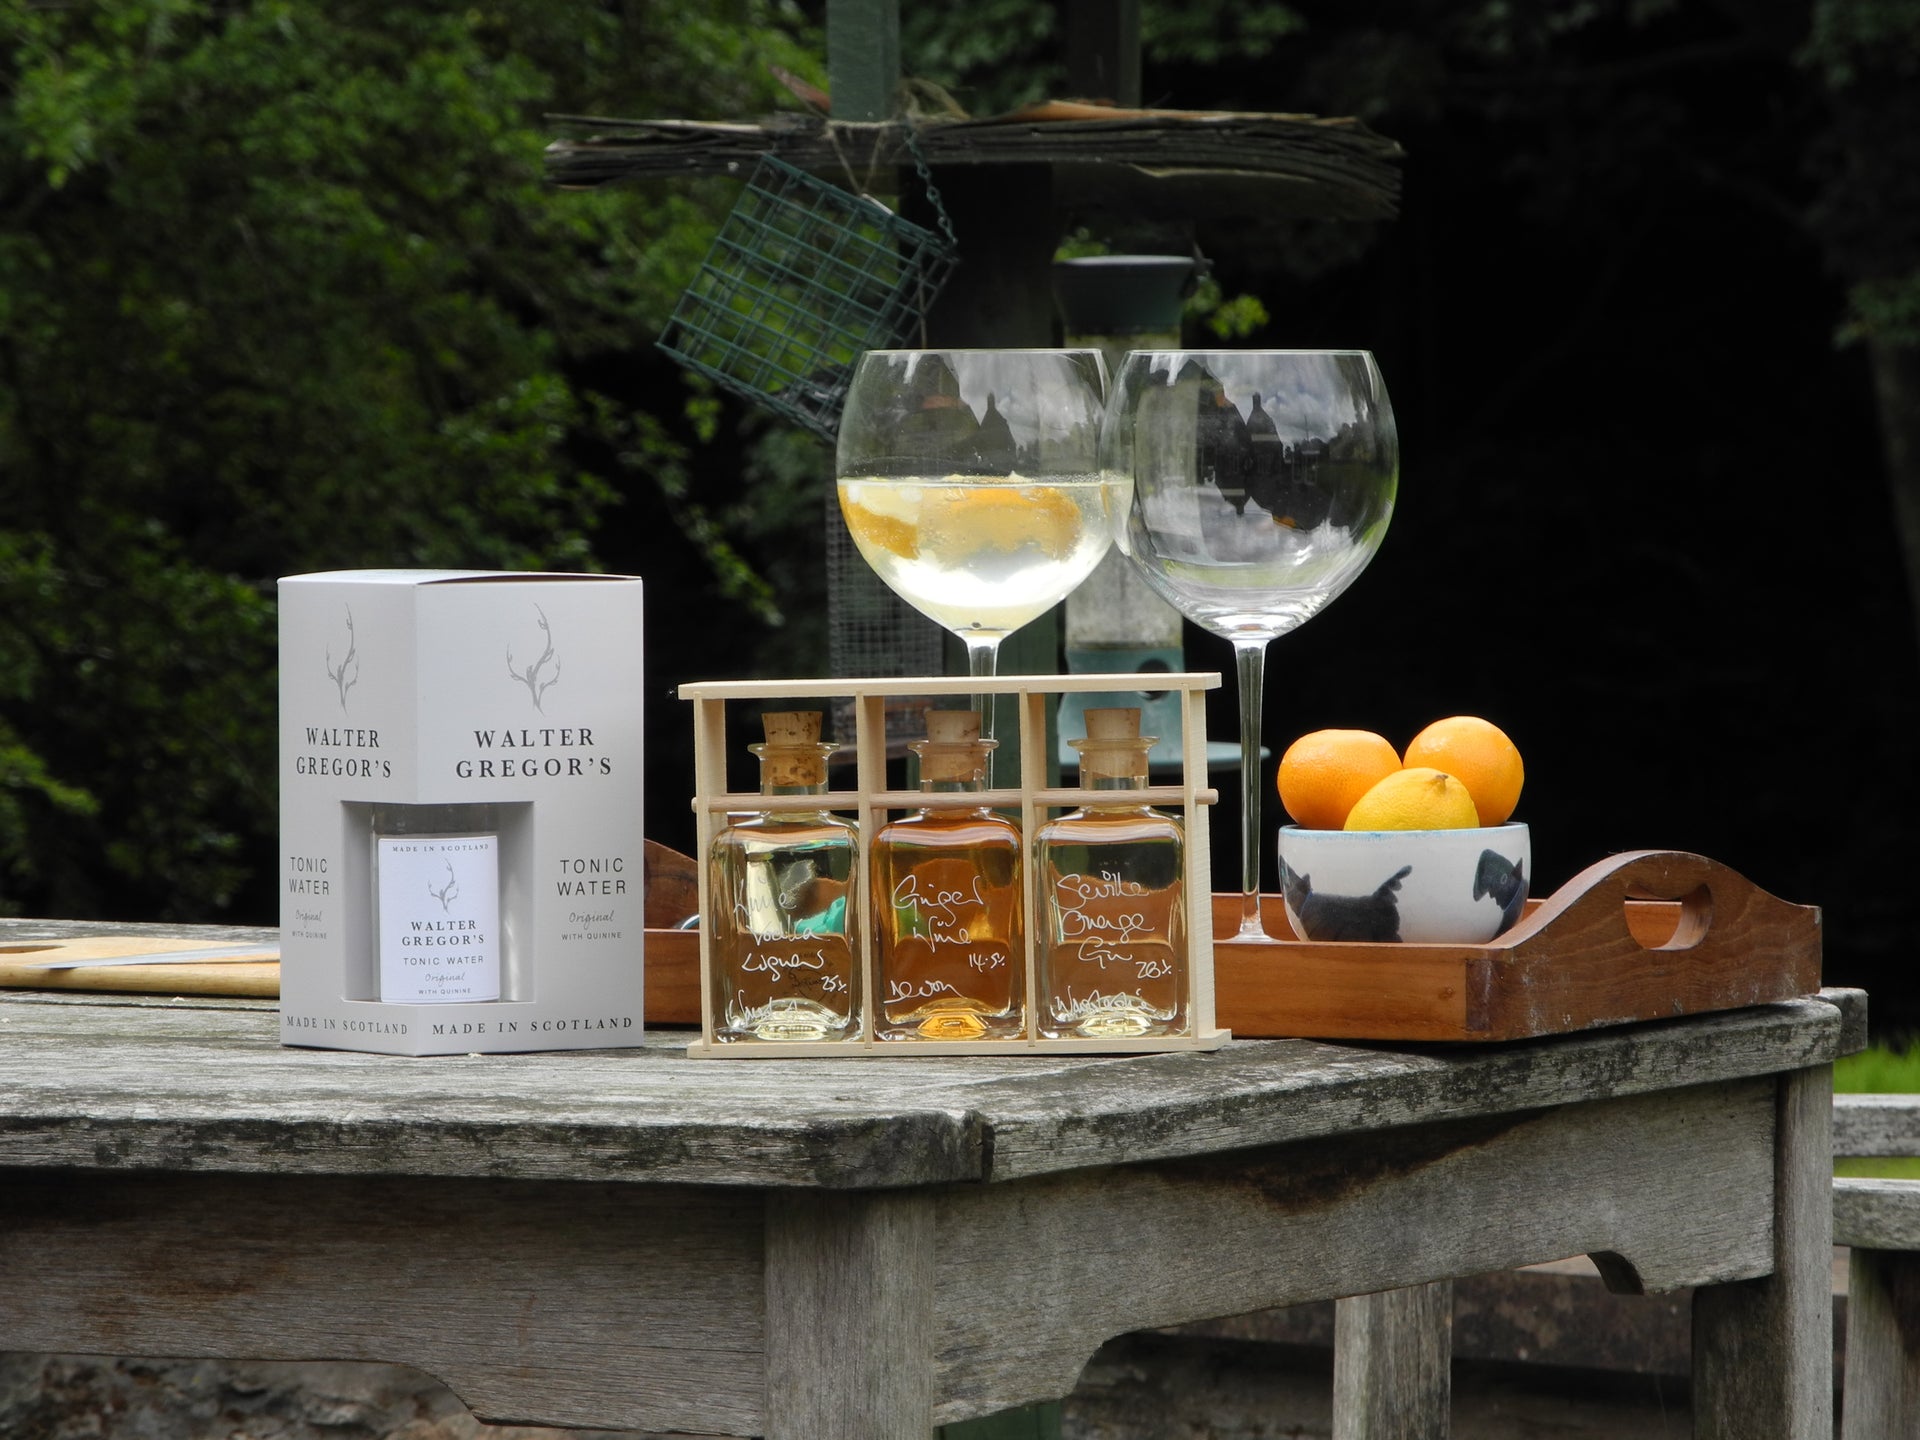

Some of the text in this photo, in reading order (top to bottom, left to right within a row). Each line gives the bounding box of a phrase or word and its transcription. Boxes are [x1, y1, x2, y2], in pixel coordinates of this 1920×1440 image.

[306, 727, 380, 748] WALTER
[473, 728, 595, 748] WALTER
[296, 756, 392, 778] GREGOR'S
[455, 756, 612, 778] GREGOR'S
[441, 843, 489, 852] SCOTLAND
[290, 856, 328, 873] TONIC
[559, 857, 623, 874] TONIC
[288, 878, 330, 895] WATER
[556, 879, 626, 896] WATER
[1050, 870, 1150, 911] Seville
[891, 874, 984, 927] Ginger
[411, 920, 477, 931] WALTER
[568, 909, 614, 930] Original
[1062, 909, 1155, 944] Orange
[401, 934, 485, 946] GREGOR'S
[561, 931, 622, 941] WITH QUININE
[912, 915, 972, 953] Wine
[403, 955, 484, 966] TONIC WATER
[1078, 935, 1133, 969] Gin
[425, 972, 465, 987] Original
[440, 987, 472, 995] QUININE
[883, 979, 968, 1004] Devon
[286, 1015, 409, 1036] MADE IN SCOTLAND
[432, 1017, 633, 1036] MADE IN SCOTLAND
